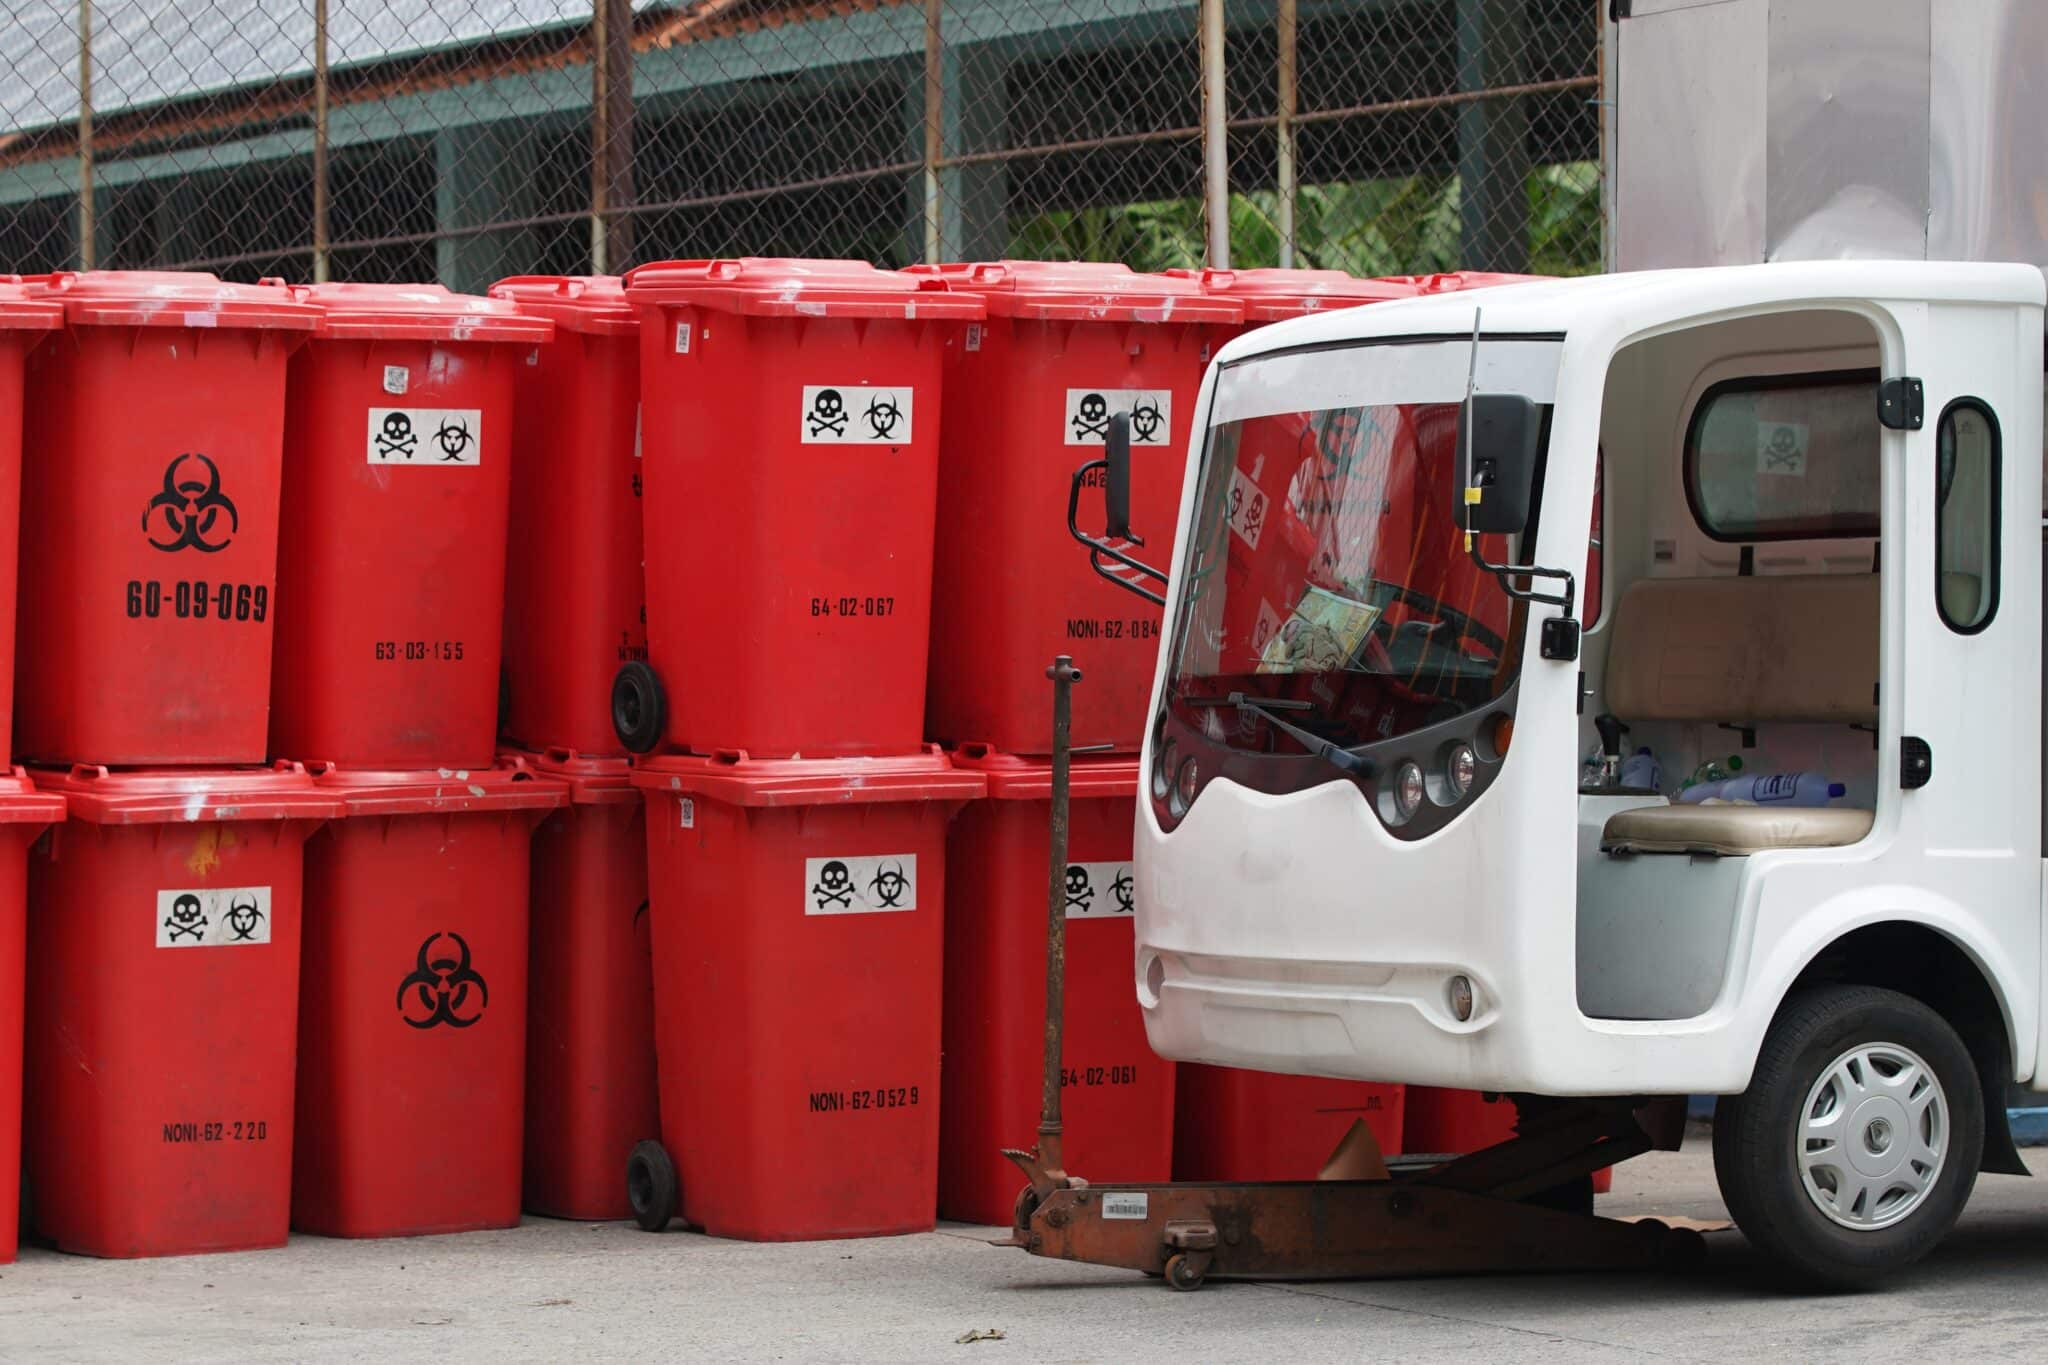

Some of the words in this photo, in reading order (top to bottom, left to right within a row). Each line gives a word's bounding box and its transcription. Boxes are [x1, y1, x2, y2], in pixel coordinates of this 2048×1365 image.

[127, 580, 268, 623] 60-09-069
[811, 597, 895, 617] 64-02-067
[375, 641, 464, 660] 63-03-155
